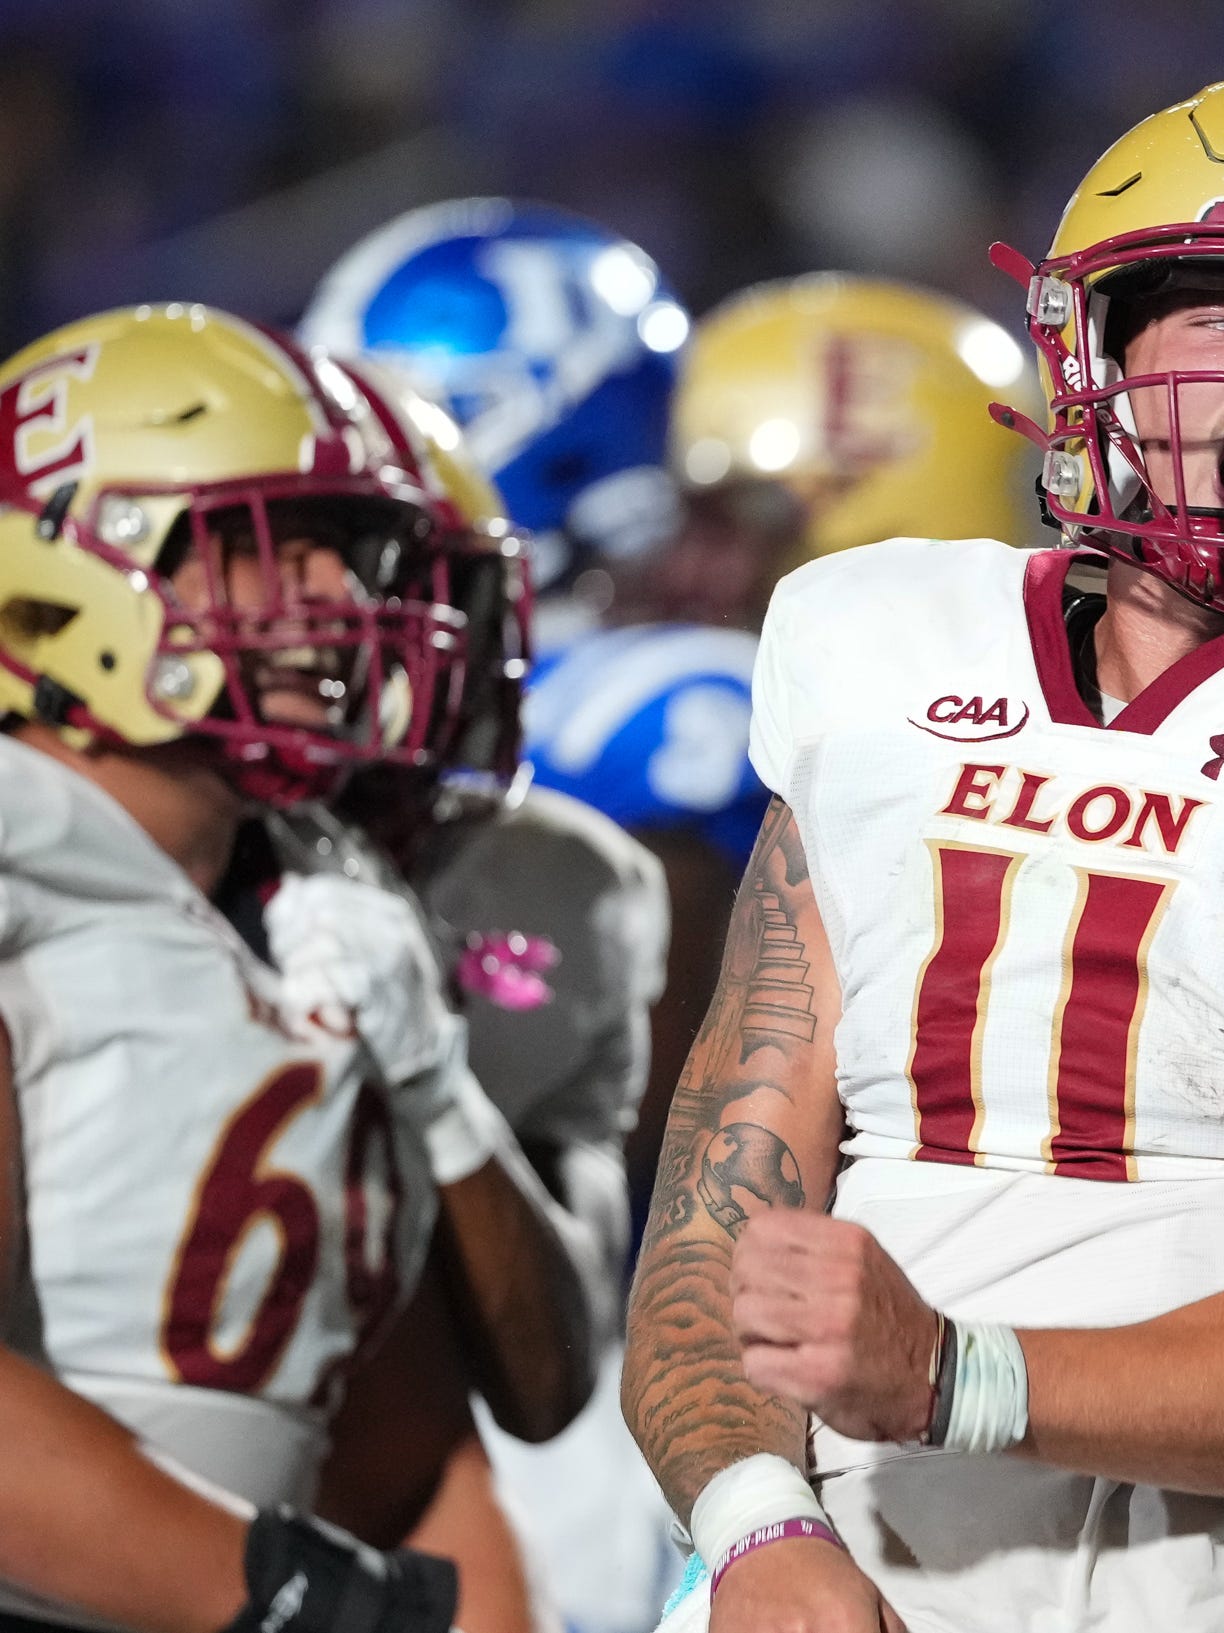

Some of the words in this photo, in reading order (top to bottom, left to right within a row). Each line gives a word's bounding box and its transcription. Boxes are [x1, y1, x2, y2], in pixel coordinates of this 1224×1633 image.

[926, 694, 1009, 727] CAA
[935, 762, 1212, 855] ELON
[904, 838, 1181, 1184] 11
